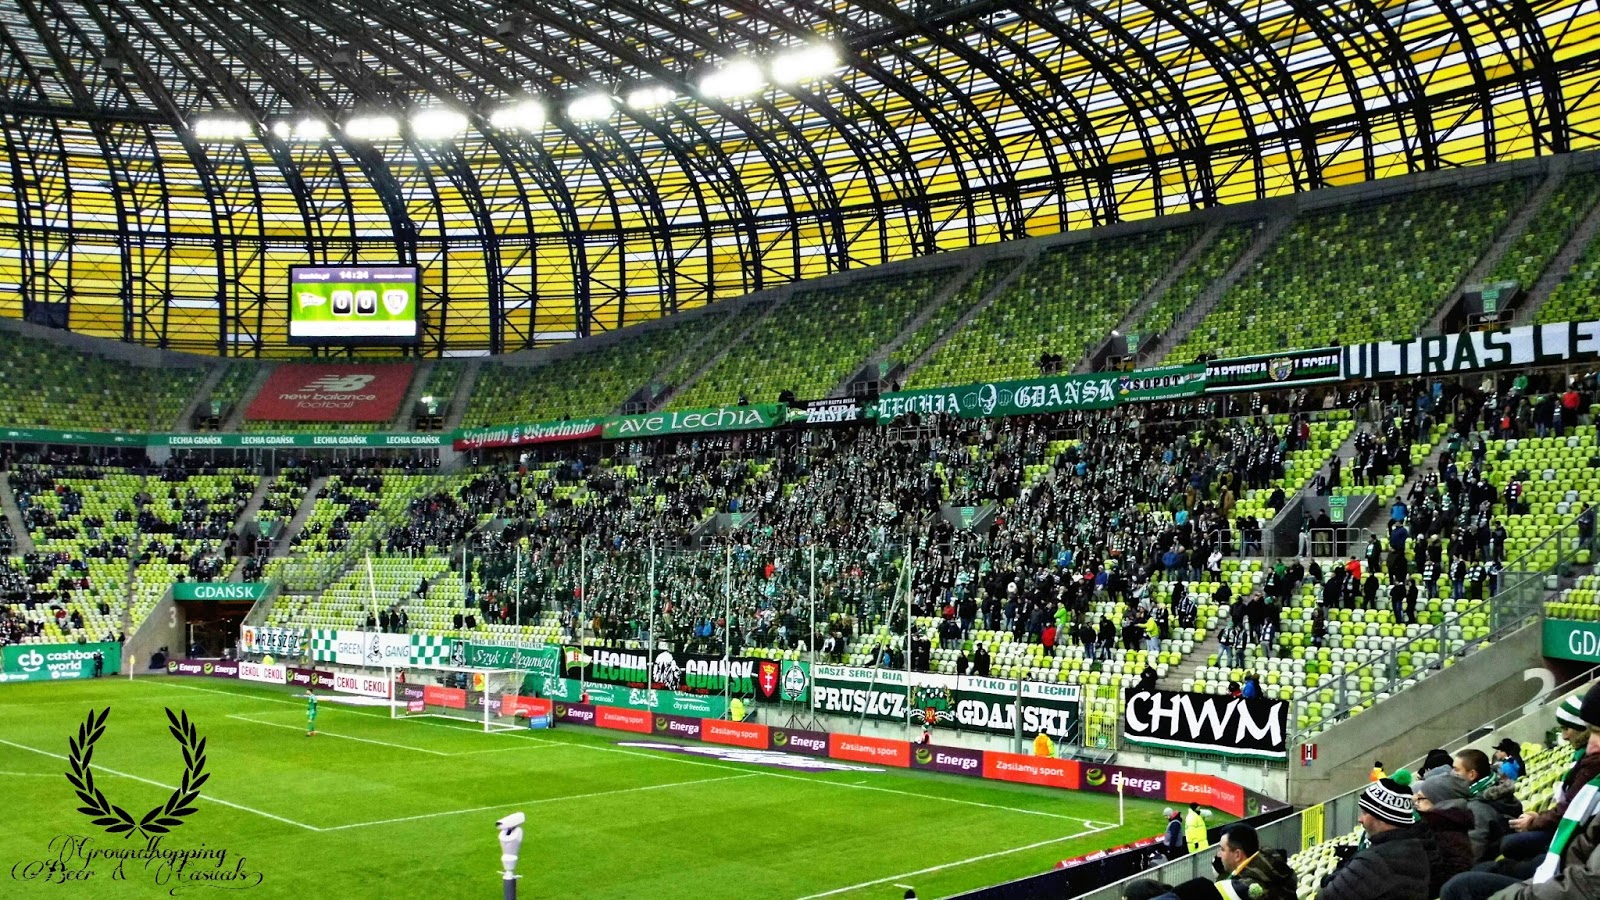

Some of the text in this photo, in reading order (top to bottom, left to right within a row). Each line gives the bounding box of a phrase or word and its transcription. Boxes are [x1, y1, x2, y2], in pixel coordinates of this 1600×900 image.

[1343, 328, 1512, 380] ULTRAS
[1133, 374, 1181, 391] SOPOT
[279, 393, 376, 401] new balance
[878, 378, 1118, 418] LECHIA GDAŃSK
[297, 401, 354, 409] football
[806, 404, 857, 423] ZASPA
[169, 435, 222, 445] LECHIA GDAŃSK
[241, 435, 294, 445] LECHIA GDAŃSK
[314, 435, 367, 445] LECHIA GDAŃSK
[386, 435, 440, 445] LECHIA GDAŃSK
[463, 428, 509, 447] Legiony
[195, 585, 254, 598] GDAŃSK
[169, 606, 177, 629] 3
[338, 642, 409, 657] GREEN GANG
[46, 660, 82, 671] world
[179, 663, 202, 673] Energa
[214, 665, 238, 675] Energa
[241, 665, 284, 680] CEKOL CEKOL
[592, 650, 754, 694] LECHIA GDAŃSK
[818, 667, 845, 676] NASZE
[294, 672, 311, 684] Energa
[319, 675, 334, 687] Energa
[337, 677, 387, 693] CEKOL CEKOL
[404, 687, 424, 699] Energa
[968, 678, 1076, 697] TYLKO DA LECHII
[1523, 667, 1556, 715] 2
[814, 686, 906, 718] PRUSZCZ
[568, 707, 594, 720] Energa
[604, 712, 644, 726] Zasilamy sport
[1125, 690, 1283, 747] CHWM
[670, 720, 699, 734] Energa
[710, 725, 759, 740] Zasilamy sport
[790, 735, 826, 750] Energa
[840, 742, 898, 757] Zasilamy sport
[936, 753, 978, 769] Energa
[996, 760, 1064, 777] Zasilamy sport
[1111, 773, 1161, 792] Energa
[1181, 782, 1221, 799] Zasilamy
